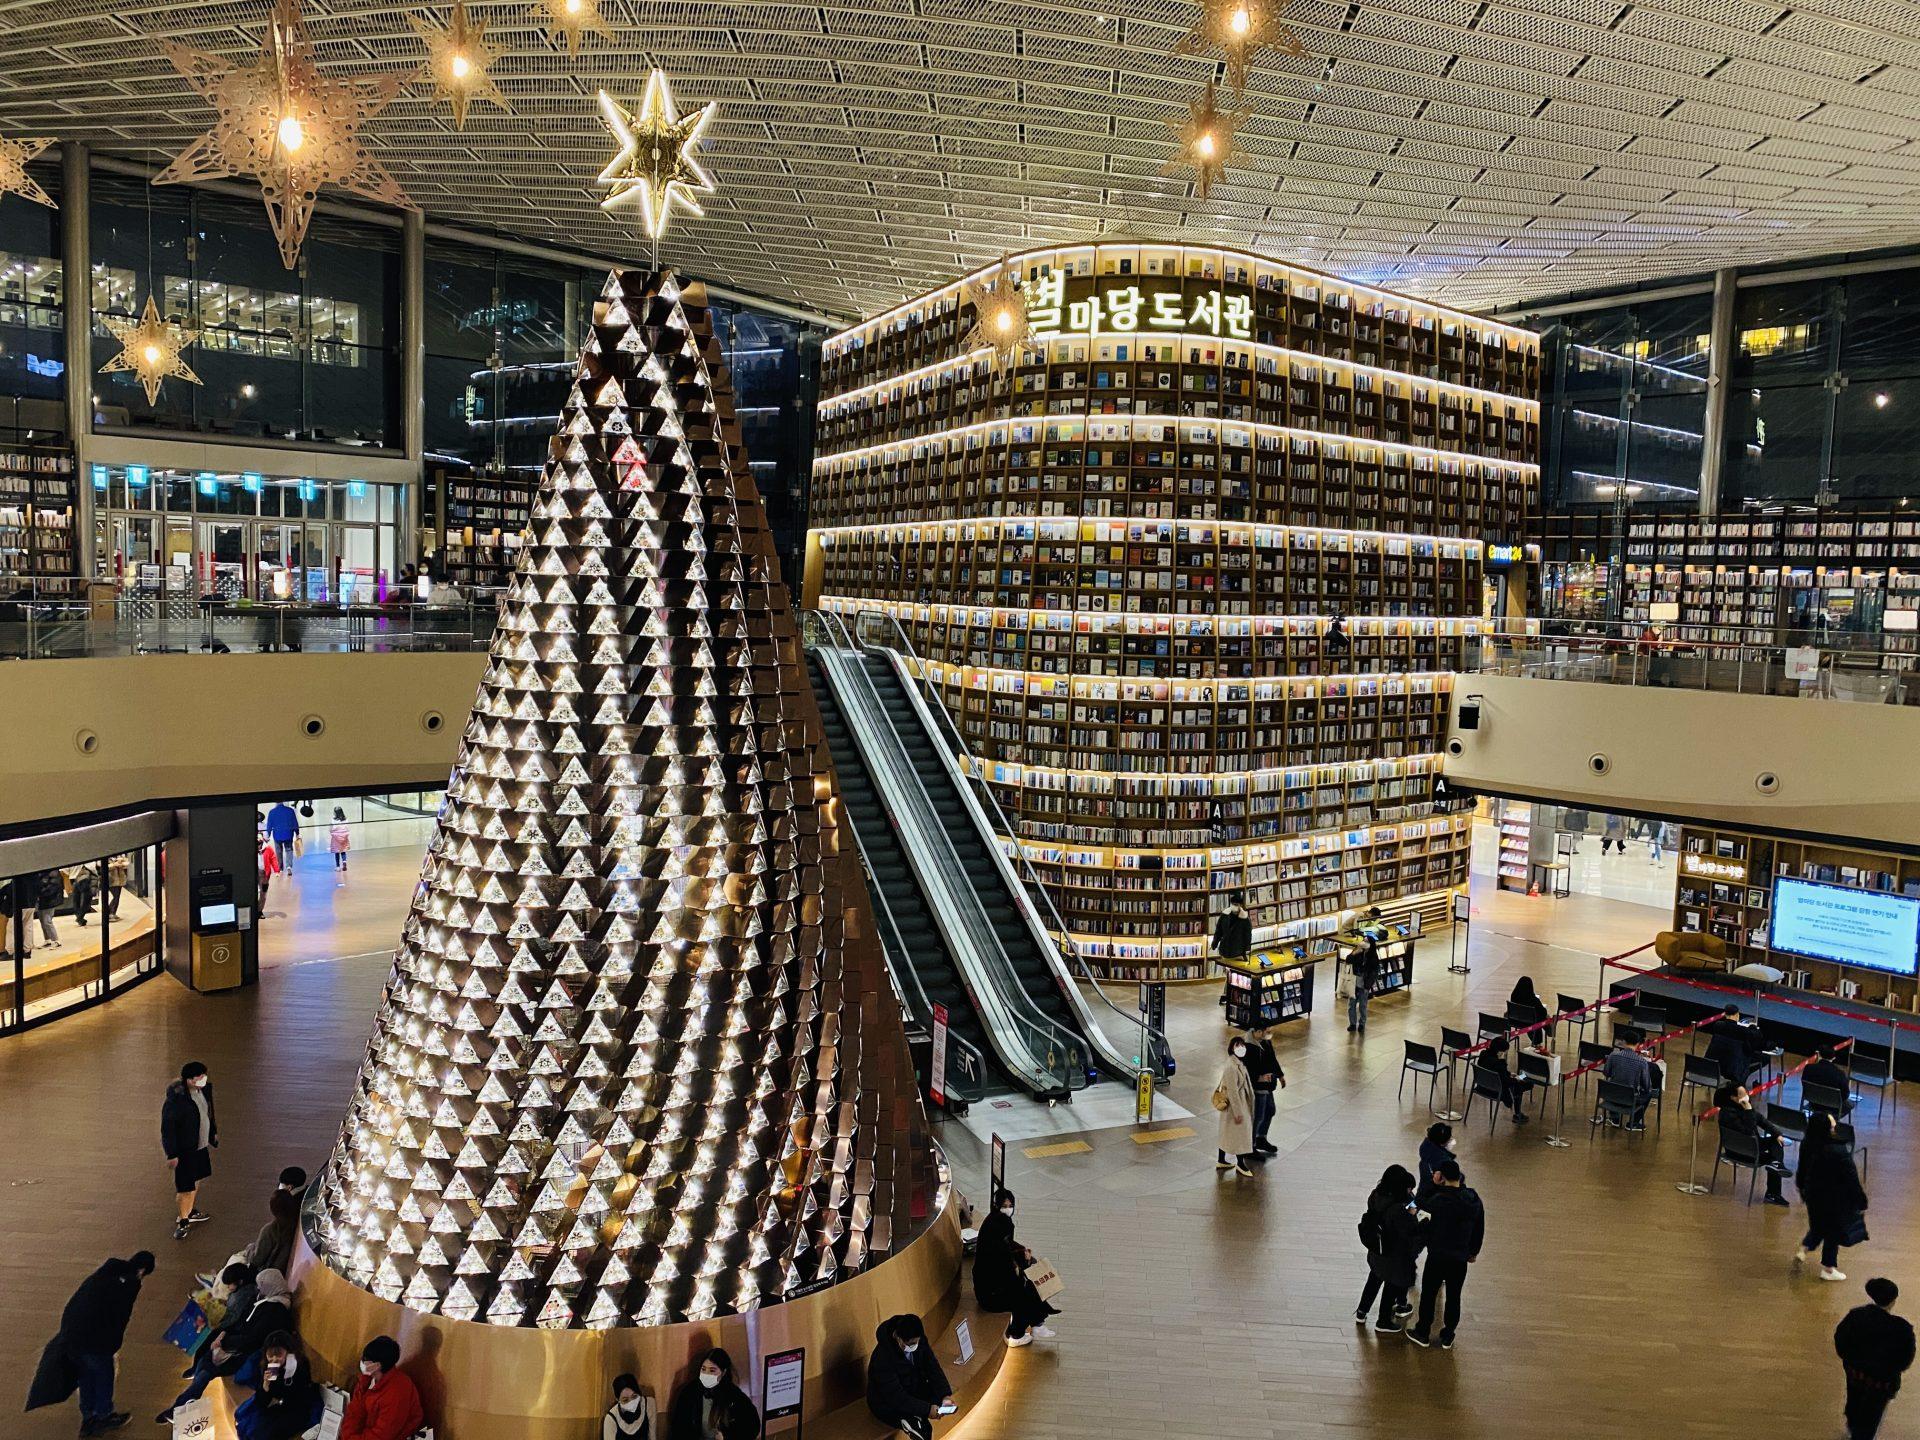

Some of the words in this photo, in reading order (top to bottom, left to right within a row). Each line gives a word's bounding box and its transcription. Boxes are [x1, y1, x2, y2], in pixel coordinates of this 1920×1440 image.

[1022, 269, 1145, 337] 별마당
[1149, 290, 1254, 338] 도서관
[1435, 779, 1446, 793] A
[1213, 803, 1222, 819] A
